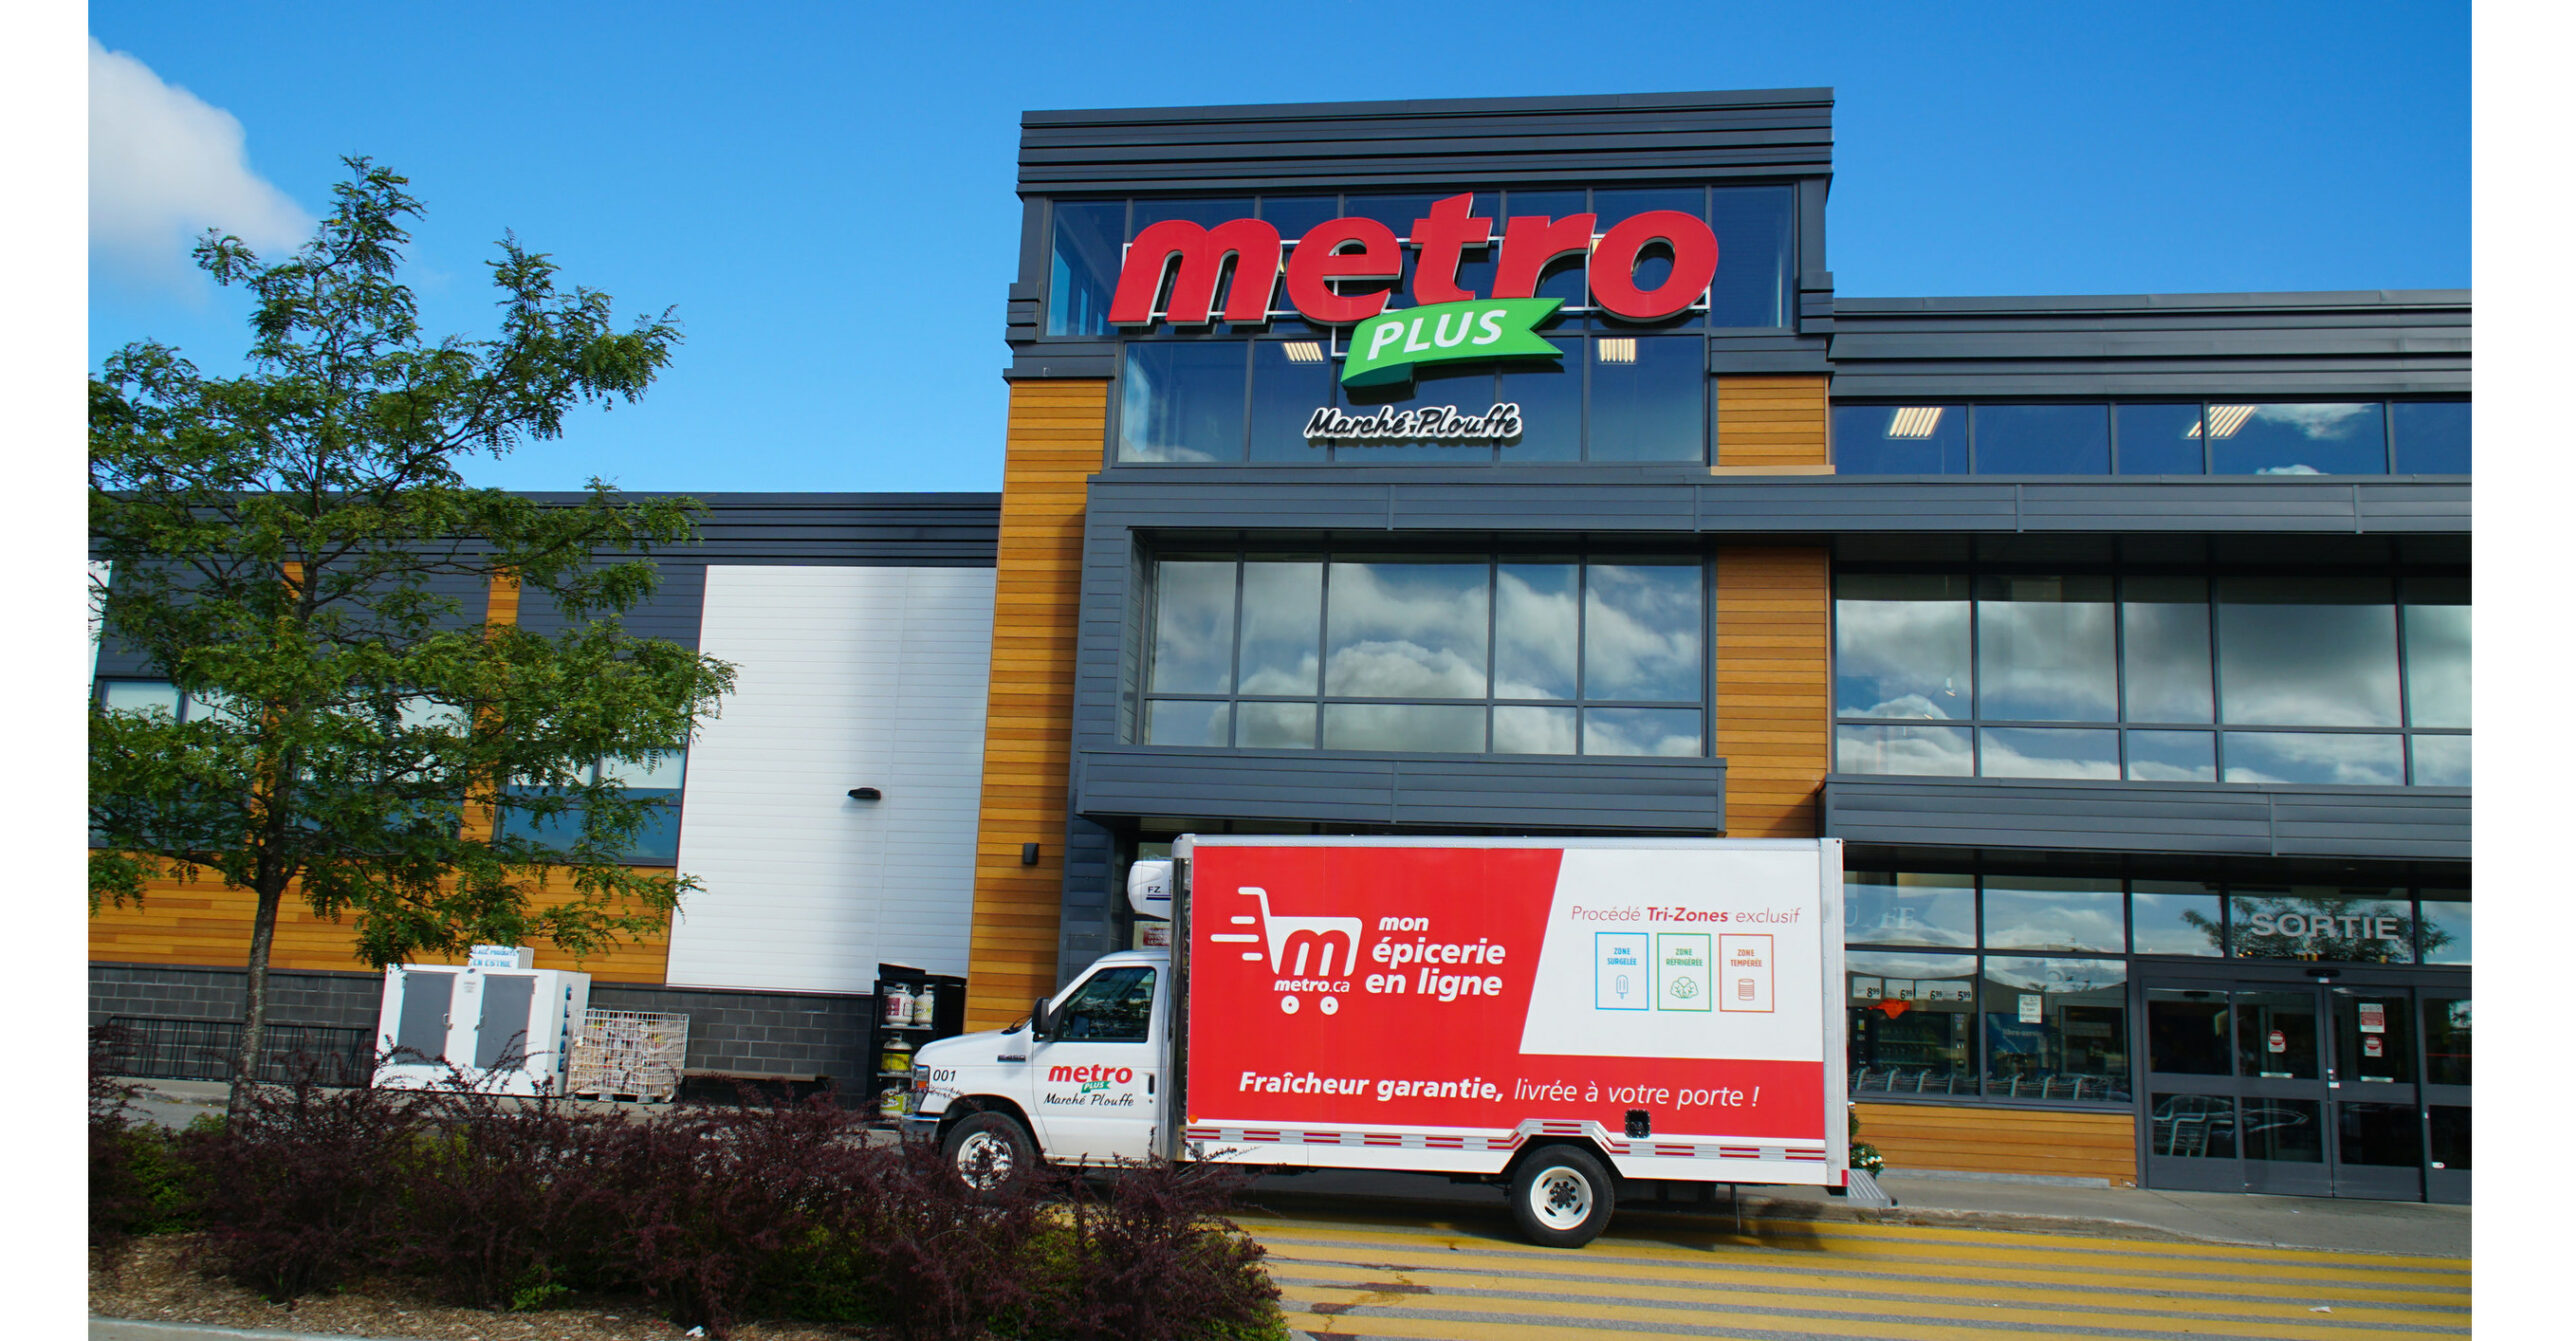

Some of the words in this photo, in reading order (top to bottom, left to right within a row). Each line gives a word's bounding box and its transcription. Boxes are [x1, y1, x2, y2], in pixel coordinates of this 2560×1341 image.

[1108, 191, 1718, 325] metro
[1367, 309, 1507, 361] PLUS
[1304, 404, 1413, 438] Marché
[1415, 403, 1521, 438] Plouffe
[1378, 916, 1429, 932] mon
[1571, 905, 1641, 922] Procédé
[1647, 906, 1729, 923] Tri-Zones
[1735, 906, 1801, 924] exclusif
[2250, 912, 2400, 941] SORTIE
[1372, 936, 1506, 970] épicerie
[1614, 947, 1631, 956] ZONE
[1676, 948, 1693, 957] ZONE
[1737, 948, 1755, 957] ZONE
[1273, 978, 1351, 993] metro.ca
[1365, 971, 1407, 994] en
[1417, 967, 1503, 1002] ligne
[932, 1069, 957, 1082] 001
[1048, 1064, 1133, 1084] metro
[1084, 1081, 1104, 1091] PLUS
[1239, 1071, 1370, 1096] Fraîcheur
[1376, 1076, 1504, 1103] garantie,
[1514, 1077, 1578, 1102] livrée
[1584, 1080, 1599, 1103] à
[1608, 1084, 1670, 1105] votre
[1676, 1086, 1744, 1110] porte
[1043, 1092, 1086, 1105] Marché
[1091, 1093, 1134, 1107] Plouffe
